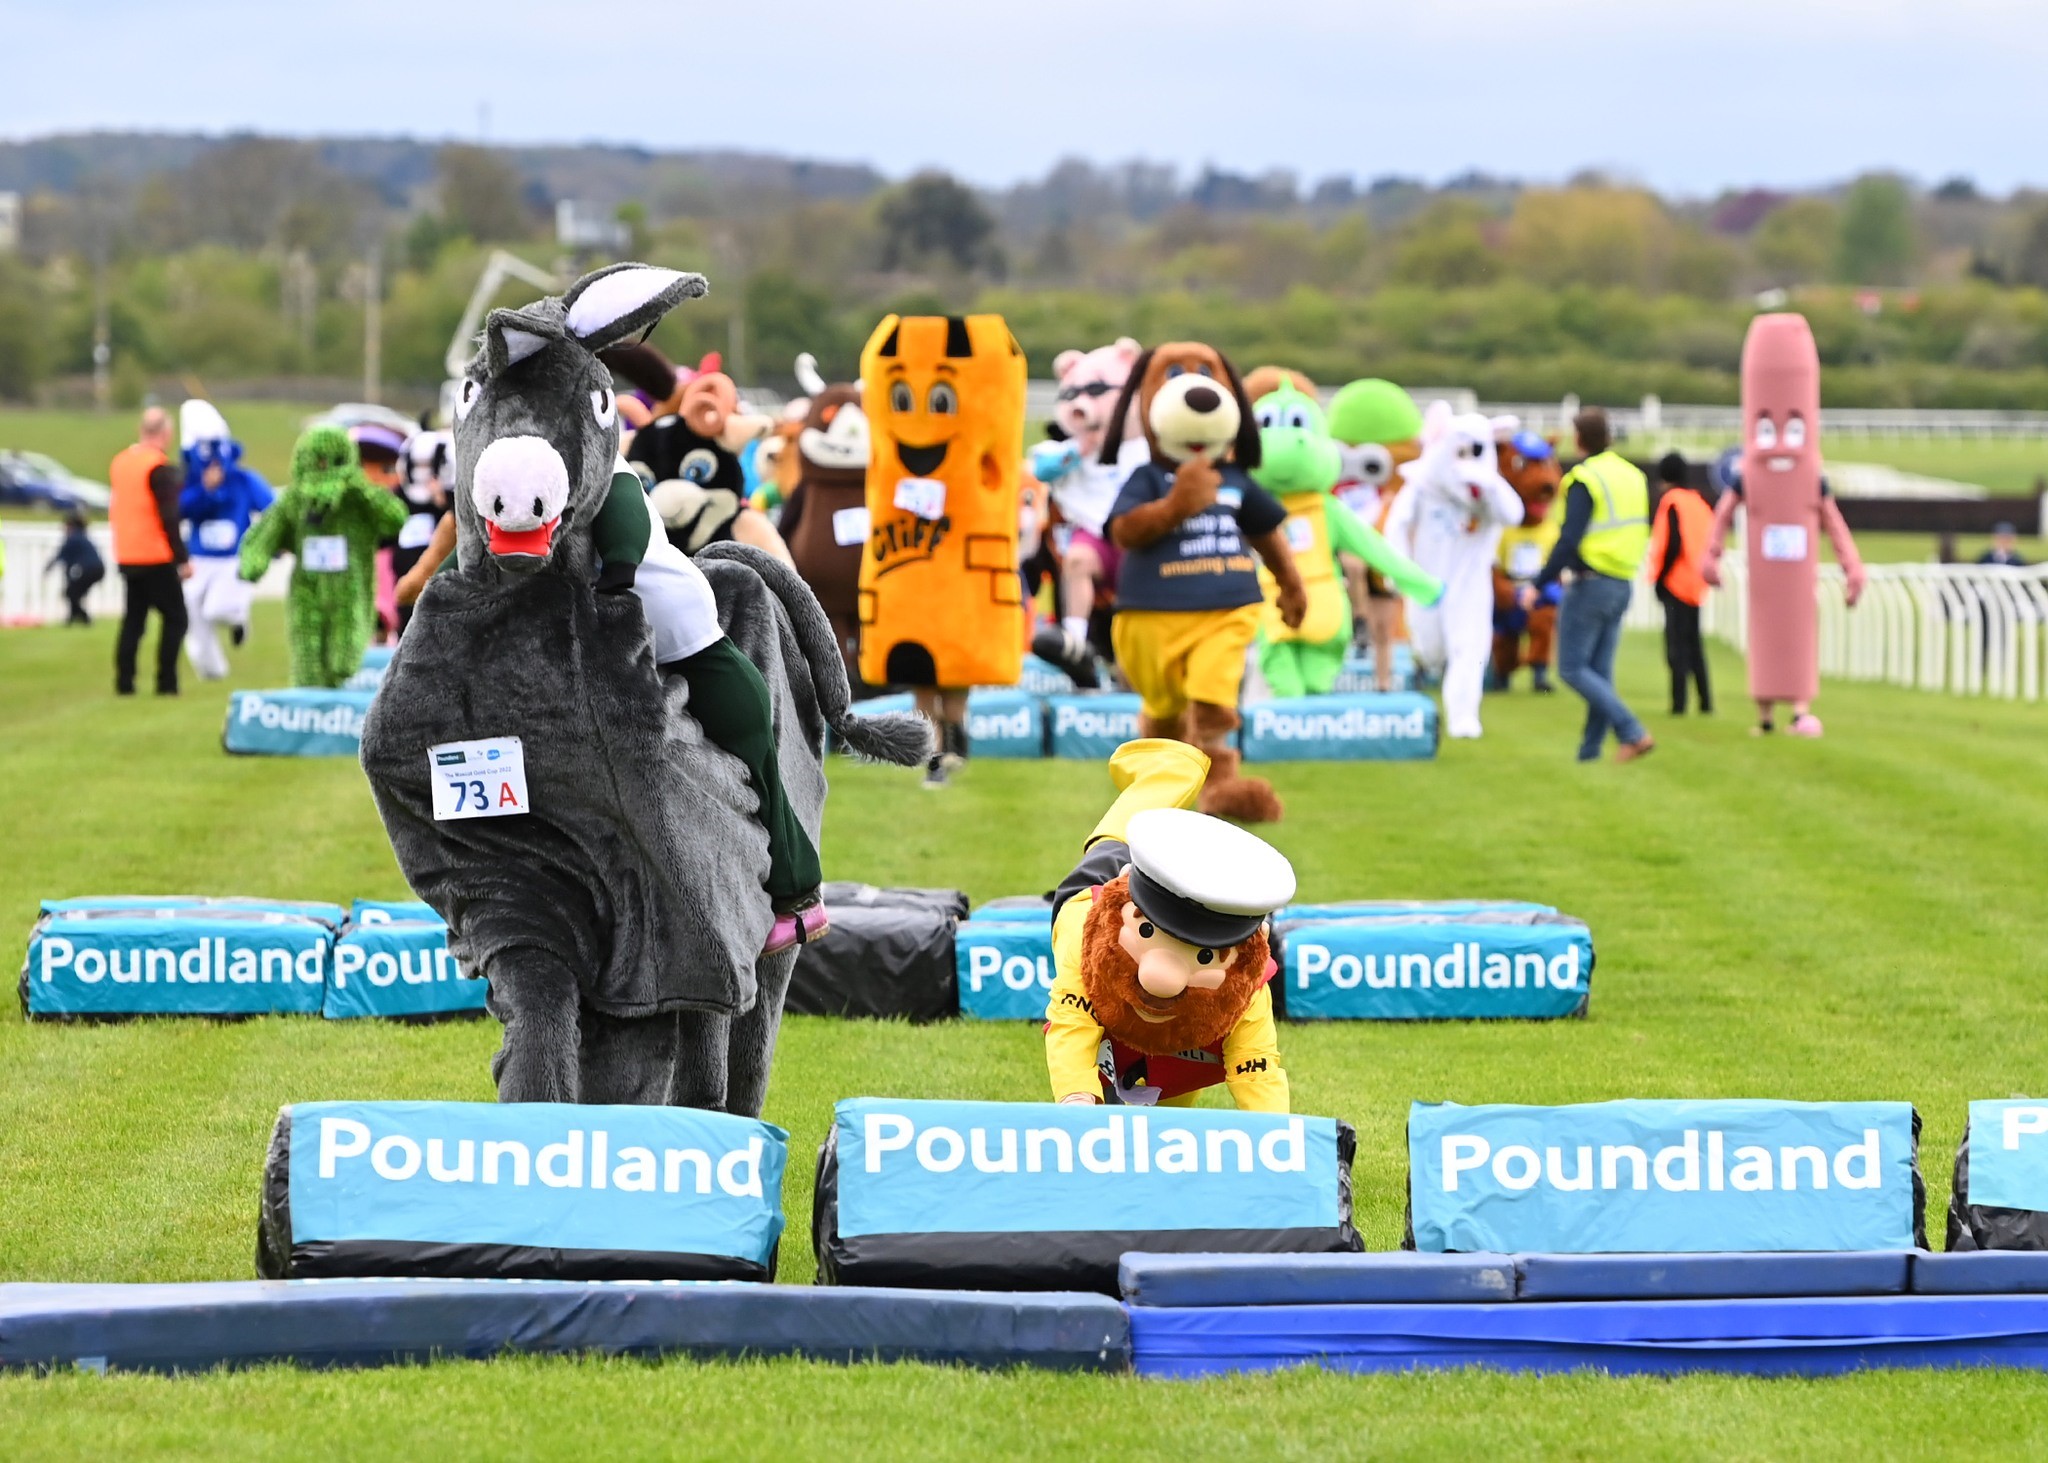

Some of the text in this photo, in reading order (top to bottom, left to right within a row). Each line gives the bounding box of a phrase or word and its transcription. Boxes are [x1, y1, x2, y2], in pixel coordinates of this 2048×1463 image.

[1252, 708, 1425, 740] Poundland
[450, 780, 518, 812] 73 A
[41, 936, 325, 983] Poundland
[1297, 942, 1579, 989] Poundland
[319, 1117, 764, 1198] Poundland
[864, 1113, 1306, 1173] Poundland
[1441, 1128, 1882, 1192] Poundland
